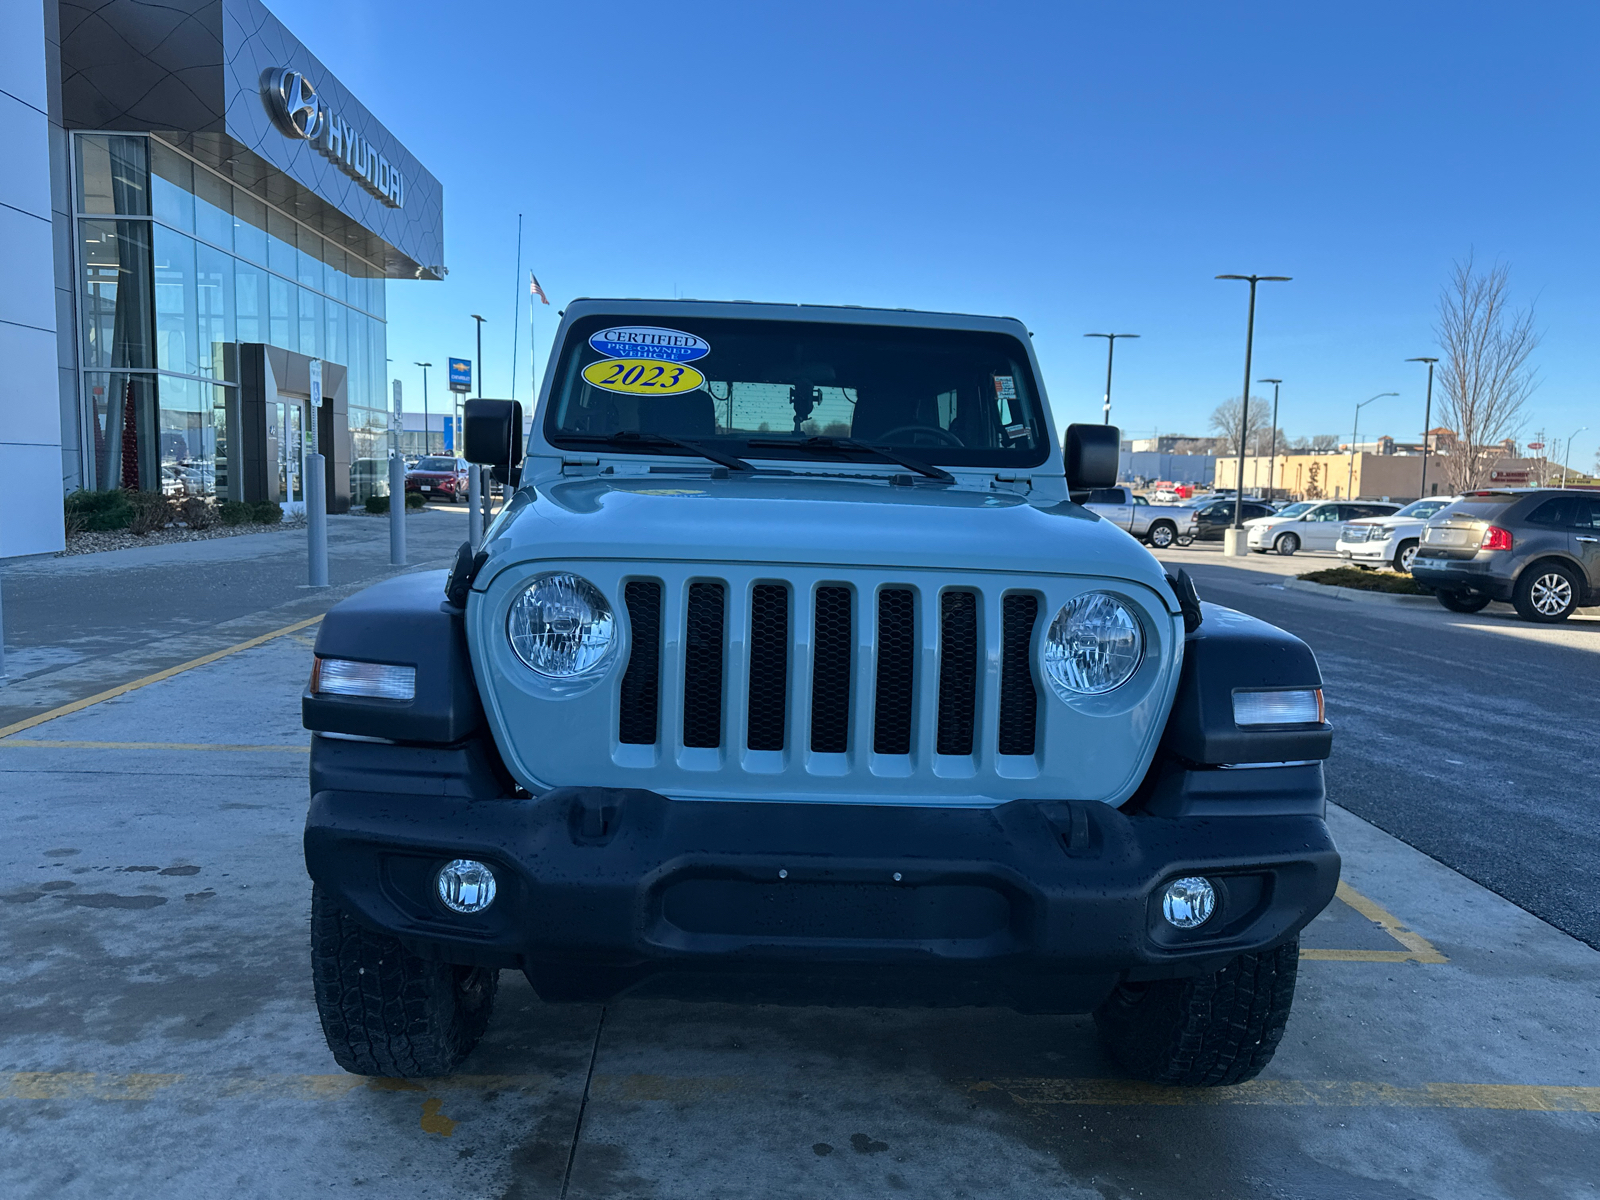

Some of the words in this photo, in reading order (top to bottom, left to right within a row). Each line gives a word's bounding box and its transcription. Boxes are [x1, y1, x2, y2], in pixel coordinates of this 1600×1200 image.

[326, 106, 404, 209] HYUNDAI
[604, 331, 698, 348] CERTIFIED
[607, 343, 692, 355] PRE-OWNED
[620, 350, 679, 361] VEHICLE
[599, 364, 685, 388] 2023
